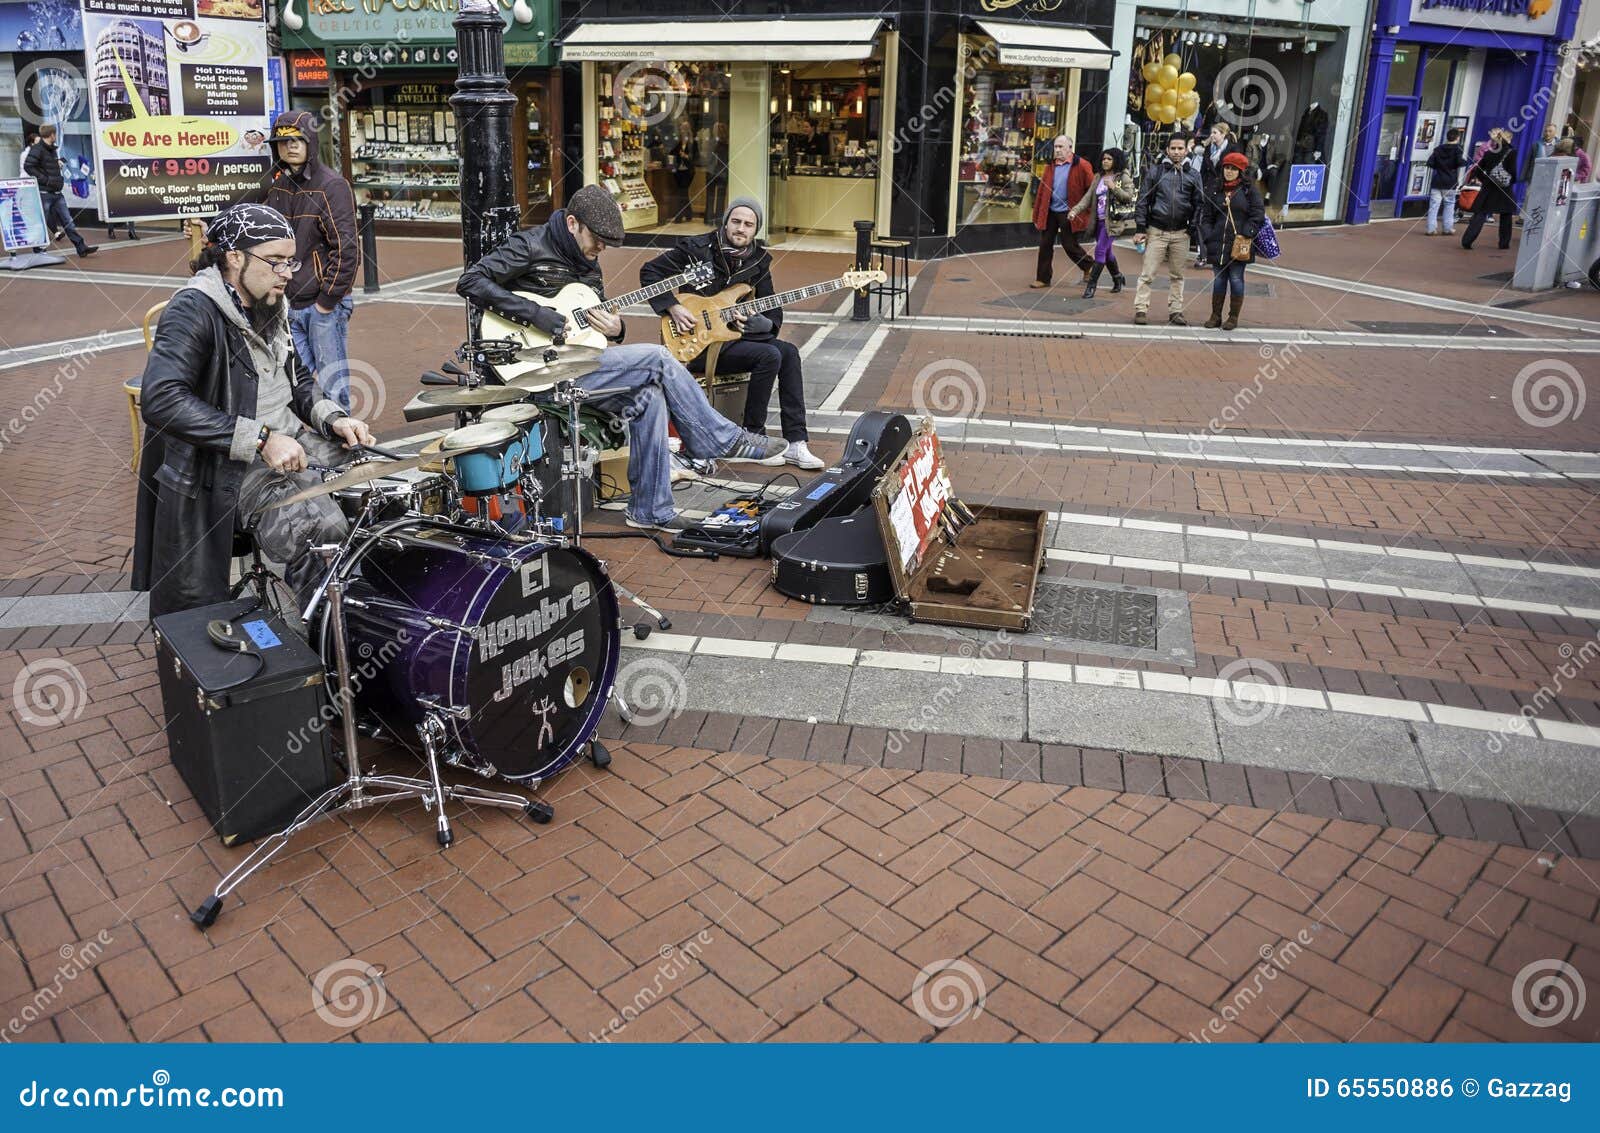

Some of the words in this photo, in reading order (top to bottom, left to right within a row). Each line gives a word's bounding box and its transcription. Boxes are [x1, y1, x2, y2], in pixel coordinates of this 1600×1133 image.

[90, 1, 103, 9] Eat
[118, 3, 140, 12] much
[153, 7, 167, 15] you
[319, 20, 382, 32] CELTIC
[393, 18, 451, 34] JEWEL
[215, 67, 245, 75] Drinks
[297, 71, 328, 80] BARBER
[218, 75, 248, 83] Drinks
[195, 82, 217, 90] Fruit
[219, 83, 248, 91] Scone
[401, 84, 439, 94] CELTIC
[207, 98, 239, 106] Danish
[393, 94, 449, 103] JEWELLER
[109, 131, 137, 147] We
[142, 131, 172, 147] Are
[177, 131, 230, 146] Here!!!
[119, 165, 149, 179] Only
[165, 158, 210, 176] 9.90
[223, 163, 262, 176] person
[125, 186, 148, 195] ADD:
[150, 186, 166, 195] Top
[167, 184, 190, 193] Floor
[197, 182, 235, 192] Stephen's
[237, 182, 261, 190] Green
[163, 195, 202, 205] Shopping
[203, 193, 231, 202] Centre
[520, 551, 550, 598] El
[478, 580, 591, 664] Hombre
